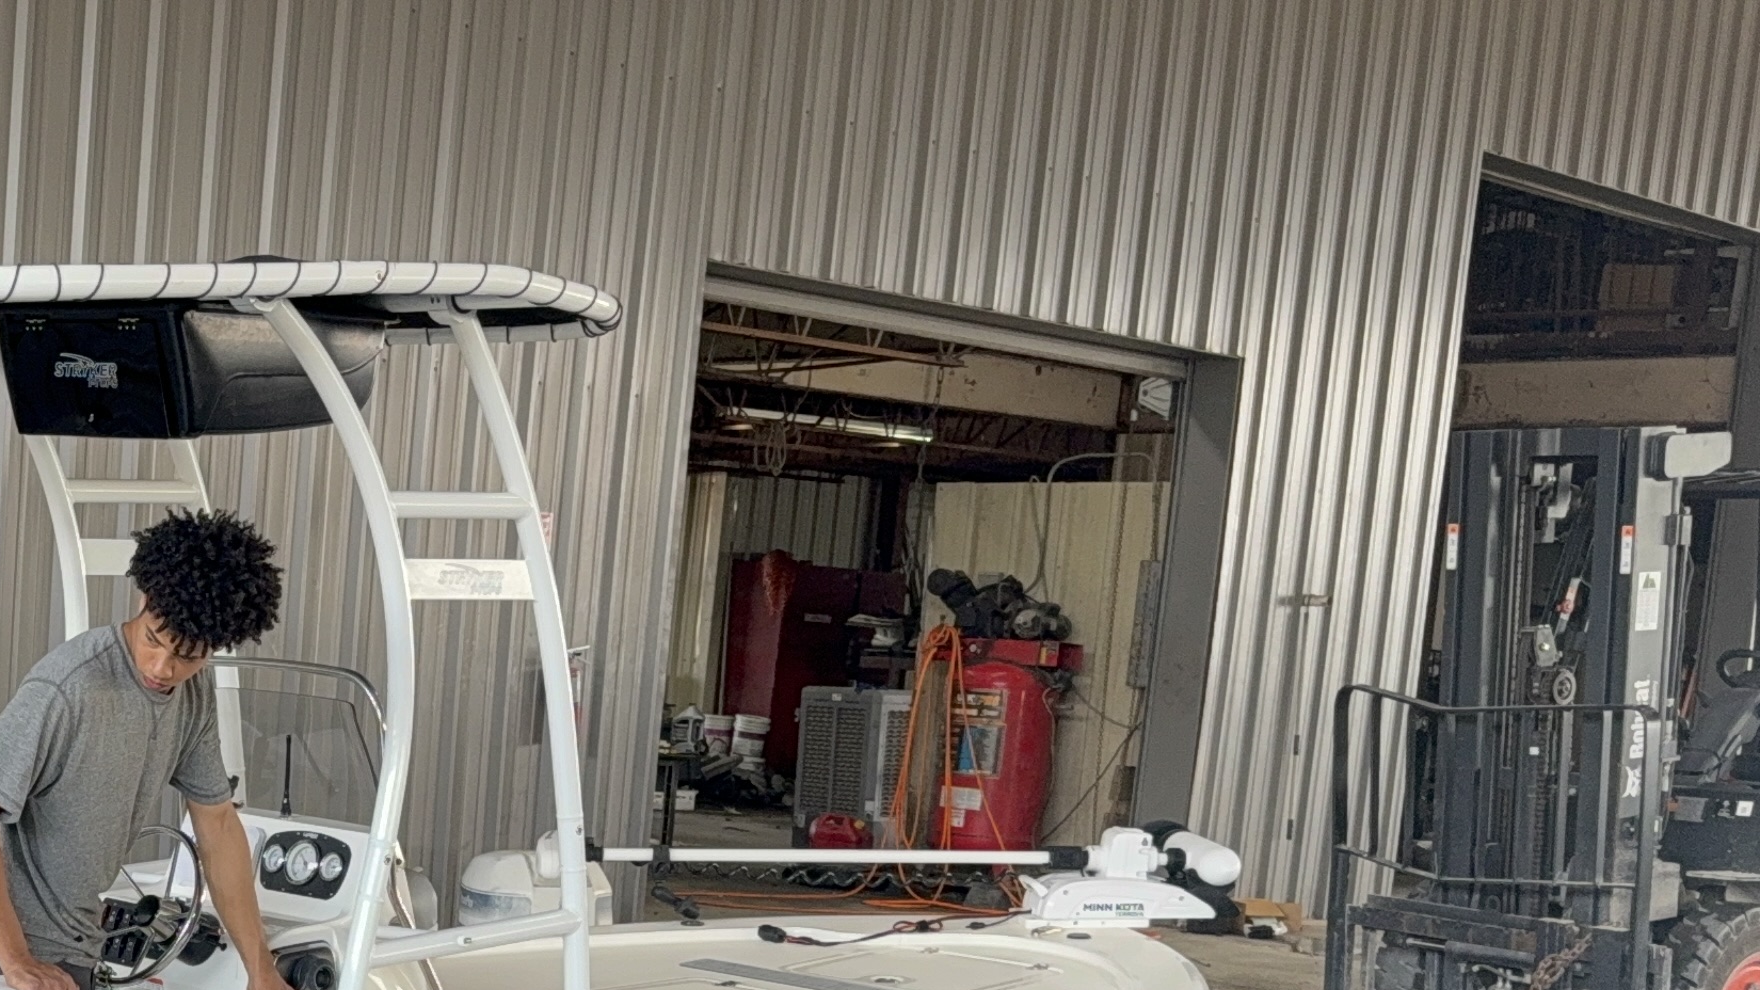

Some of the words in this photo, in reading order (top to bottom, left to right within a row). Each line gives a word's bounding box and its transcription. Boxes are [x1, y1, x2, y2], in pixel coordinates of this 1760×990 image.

[1629, 679, 1651, 759] Bobat
[1083, 903, 1113, 912] MINN
[1116, 903, 1144, 911] KOTA
